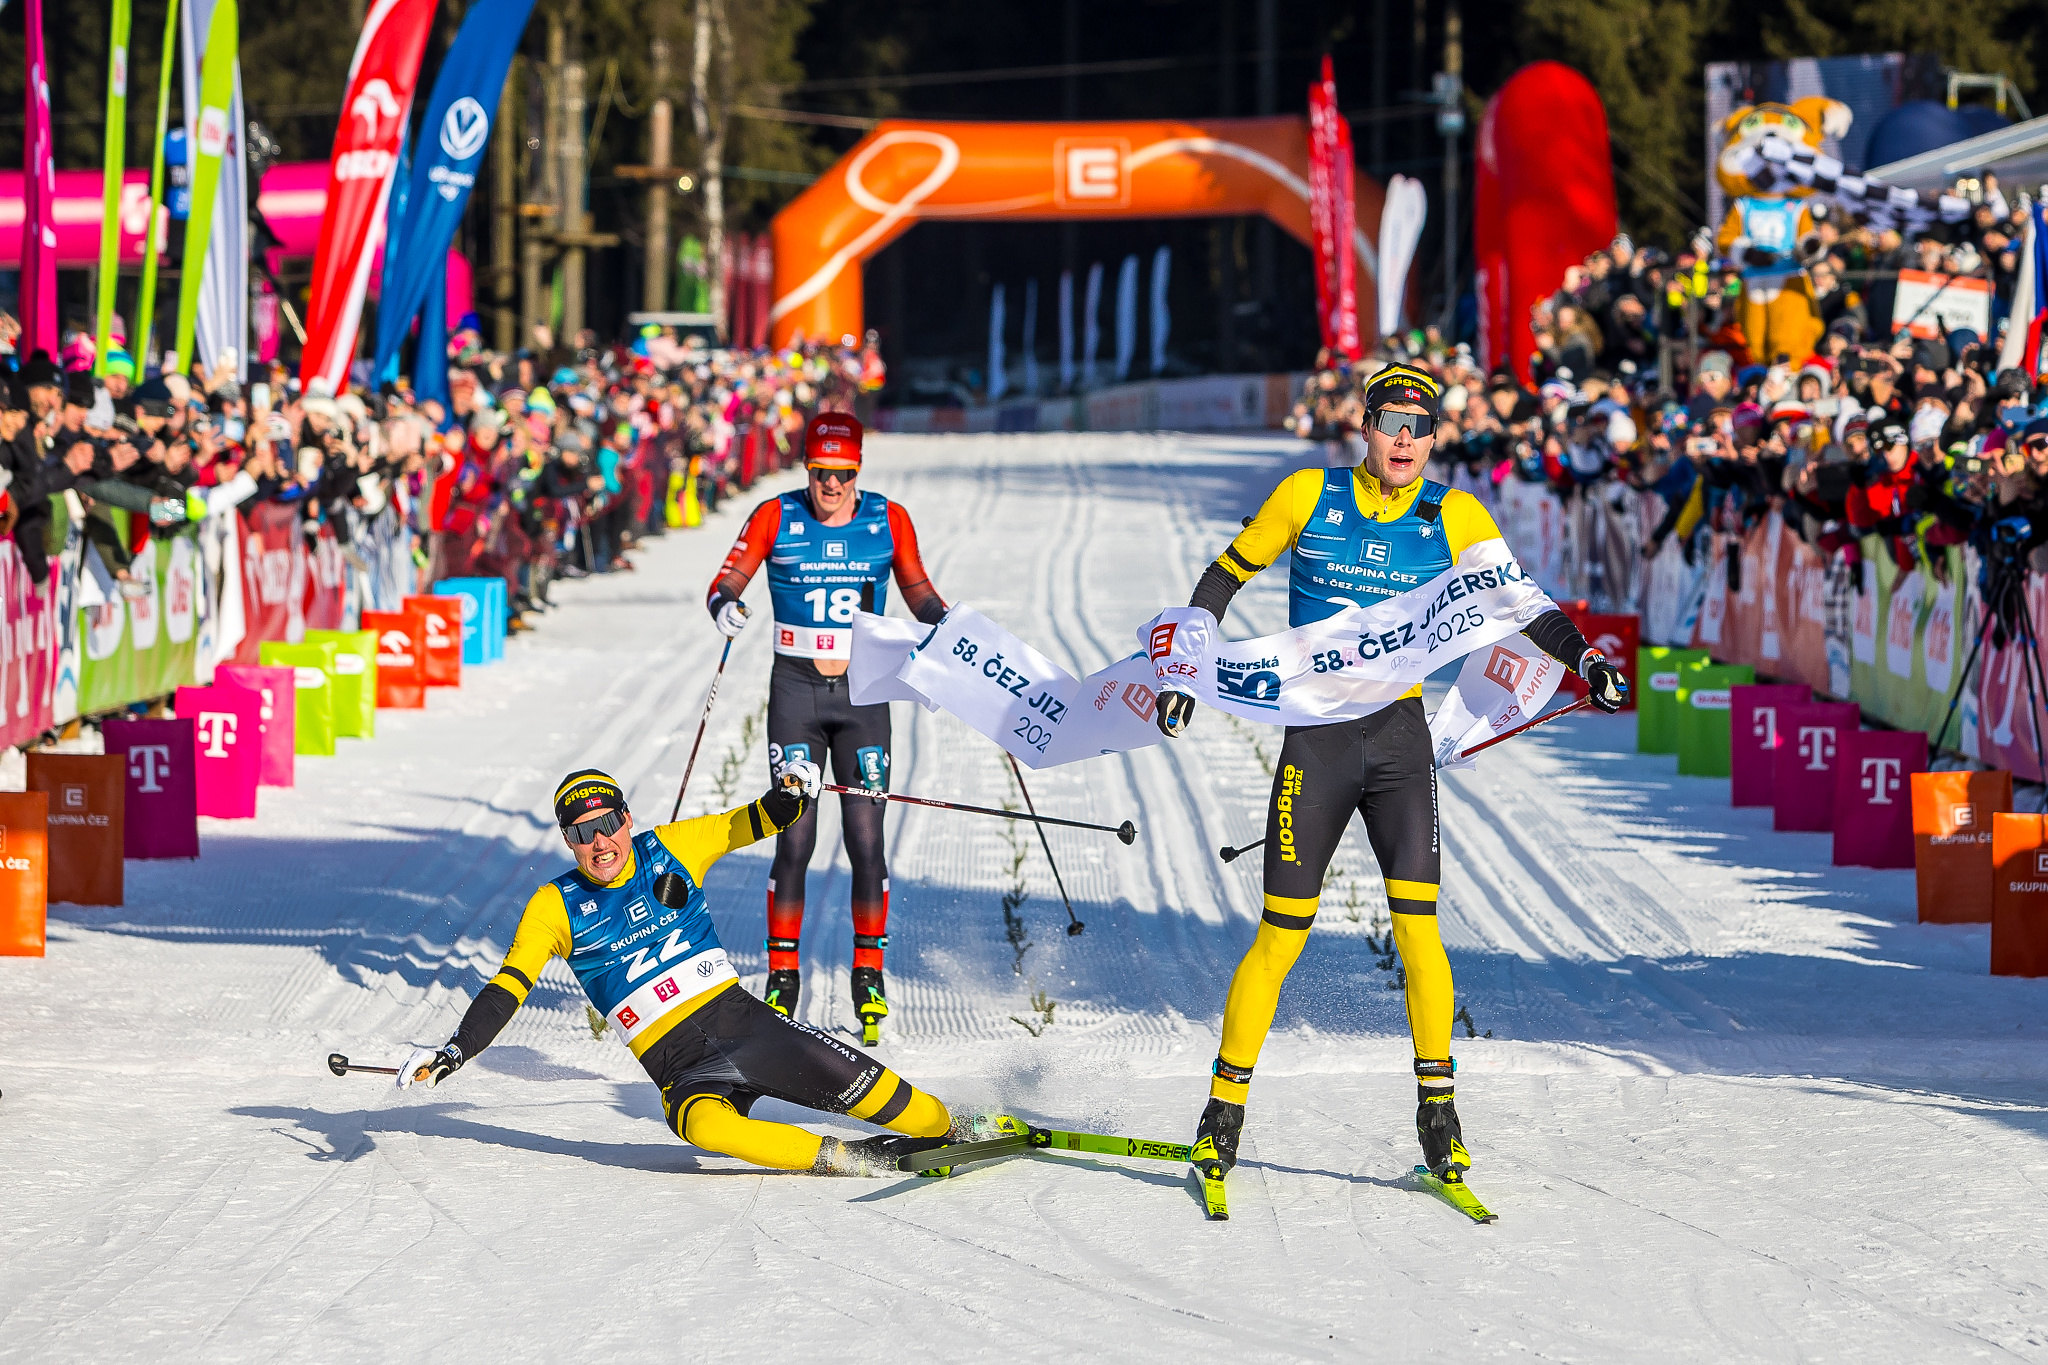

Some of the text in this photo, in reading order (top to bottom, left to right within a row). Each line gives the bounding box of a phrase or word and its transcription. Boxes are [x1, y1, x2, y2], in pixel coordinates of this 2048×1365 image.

[1384, 379, 1435, 399] engcon
[799, 561, 871, 571] SKUPINA ČEZ
[1326, 562, 1418, 585] SKUPINA ČEZ
[1312, 576, 1328, 586] 58.
[1329, 578, 1354, 591] ČEZ
[804, 588, 862, 624] 18
[1427, 605, 1485, 655] 2025
[1312, 649, 1354, 674] 58.
[1358, 621, 1416, 660] ČEZ
[1167, 661, 1198, 679] ČEZ
[1215, 656, 1280, 671] Jizerská
[952, 637, 1069, 725] 58. ČEZ JIZ
[1217, 667, 1282, 702] 50
[1013, 717, 1052, 754] 202
[1294, 769, 1304, 796] TEAM
[564, 786, 615, 806] engcon
[47, 813, 110, 827] KUPINA ČEZ
[1277, 764, 1297, 862] engcon
[1977, 831, 1993, 844] ČE
[6, 857, 31, 871] ČEZ
[610, 923, 660, 952] SKUPINA
[659, 910, 680, 927] ČEZ
[774, 1013, 858, 1063] SWEDEMOUNT
[869, 1065, 880, 1078] AS
